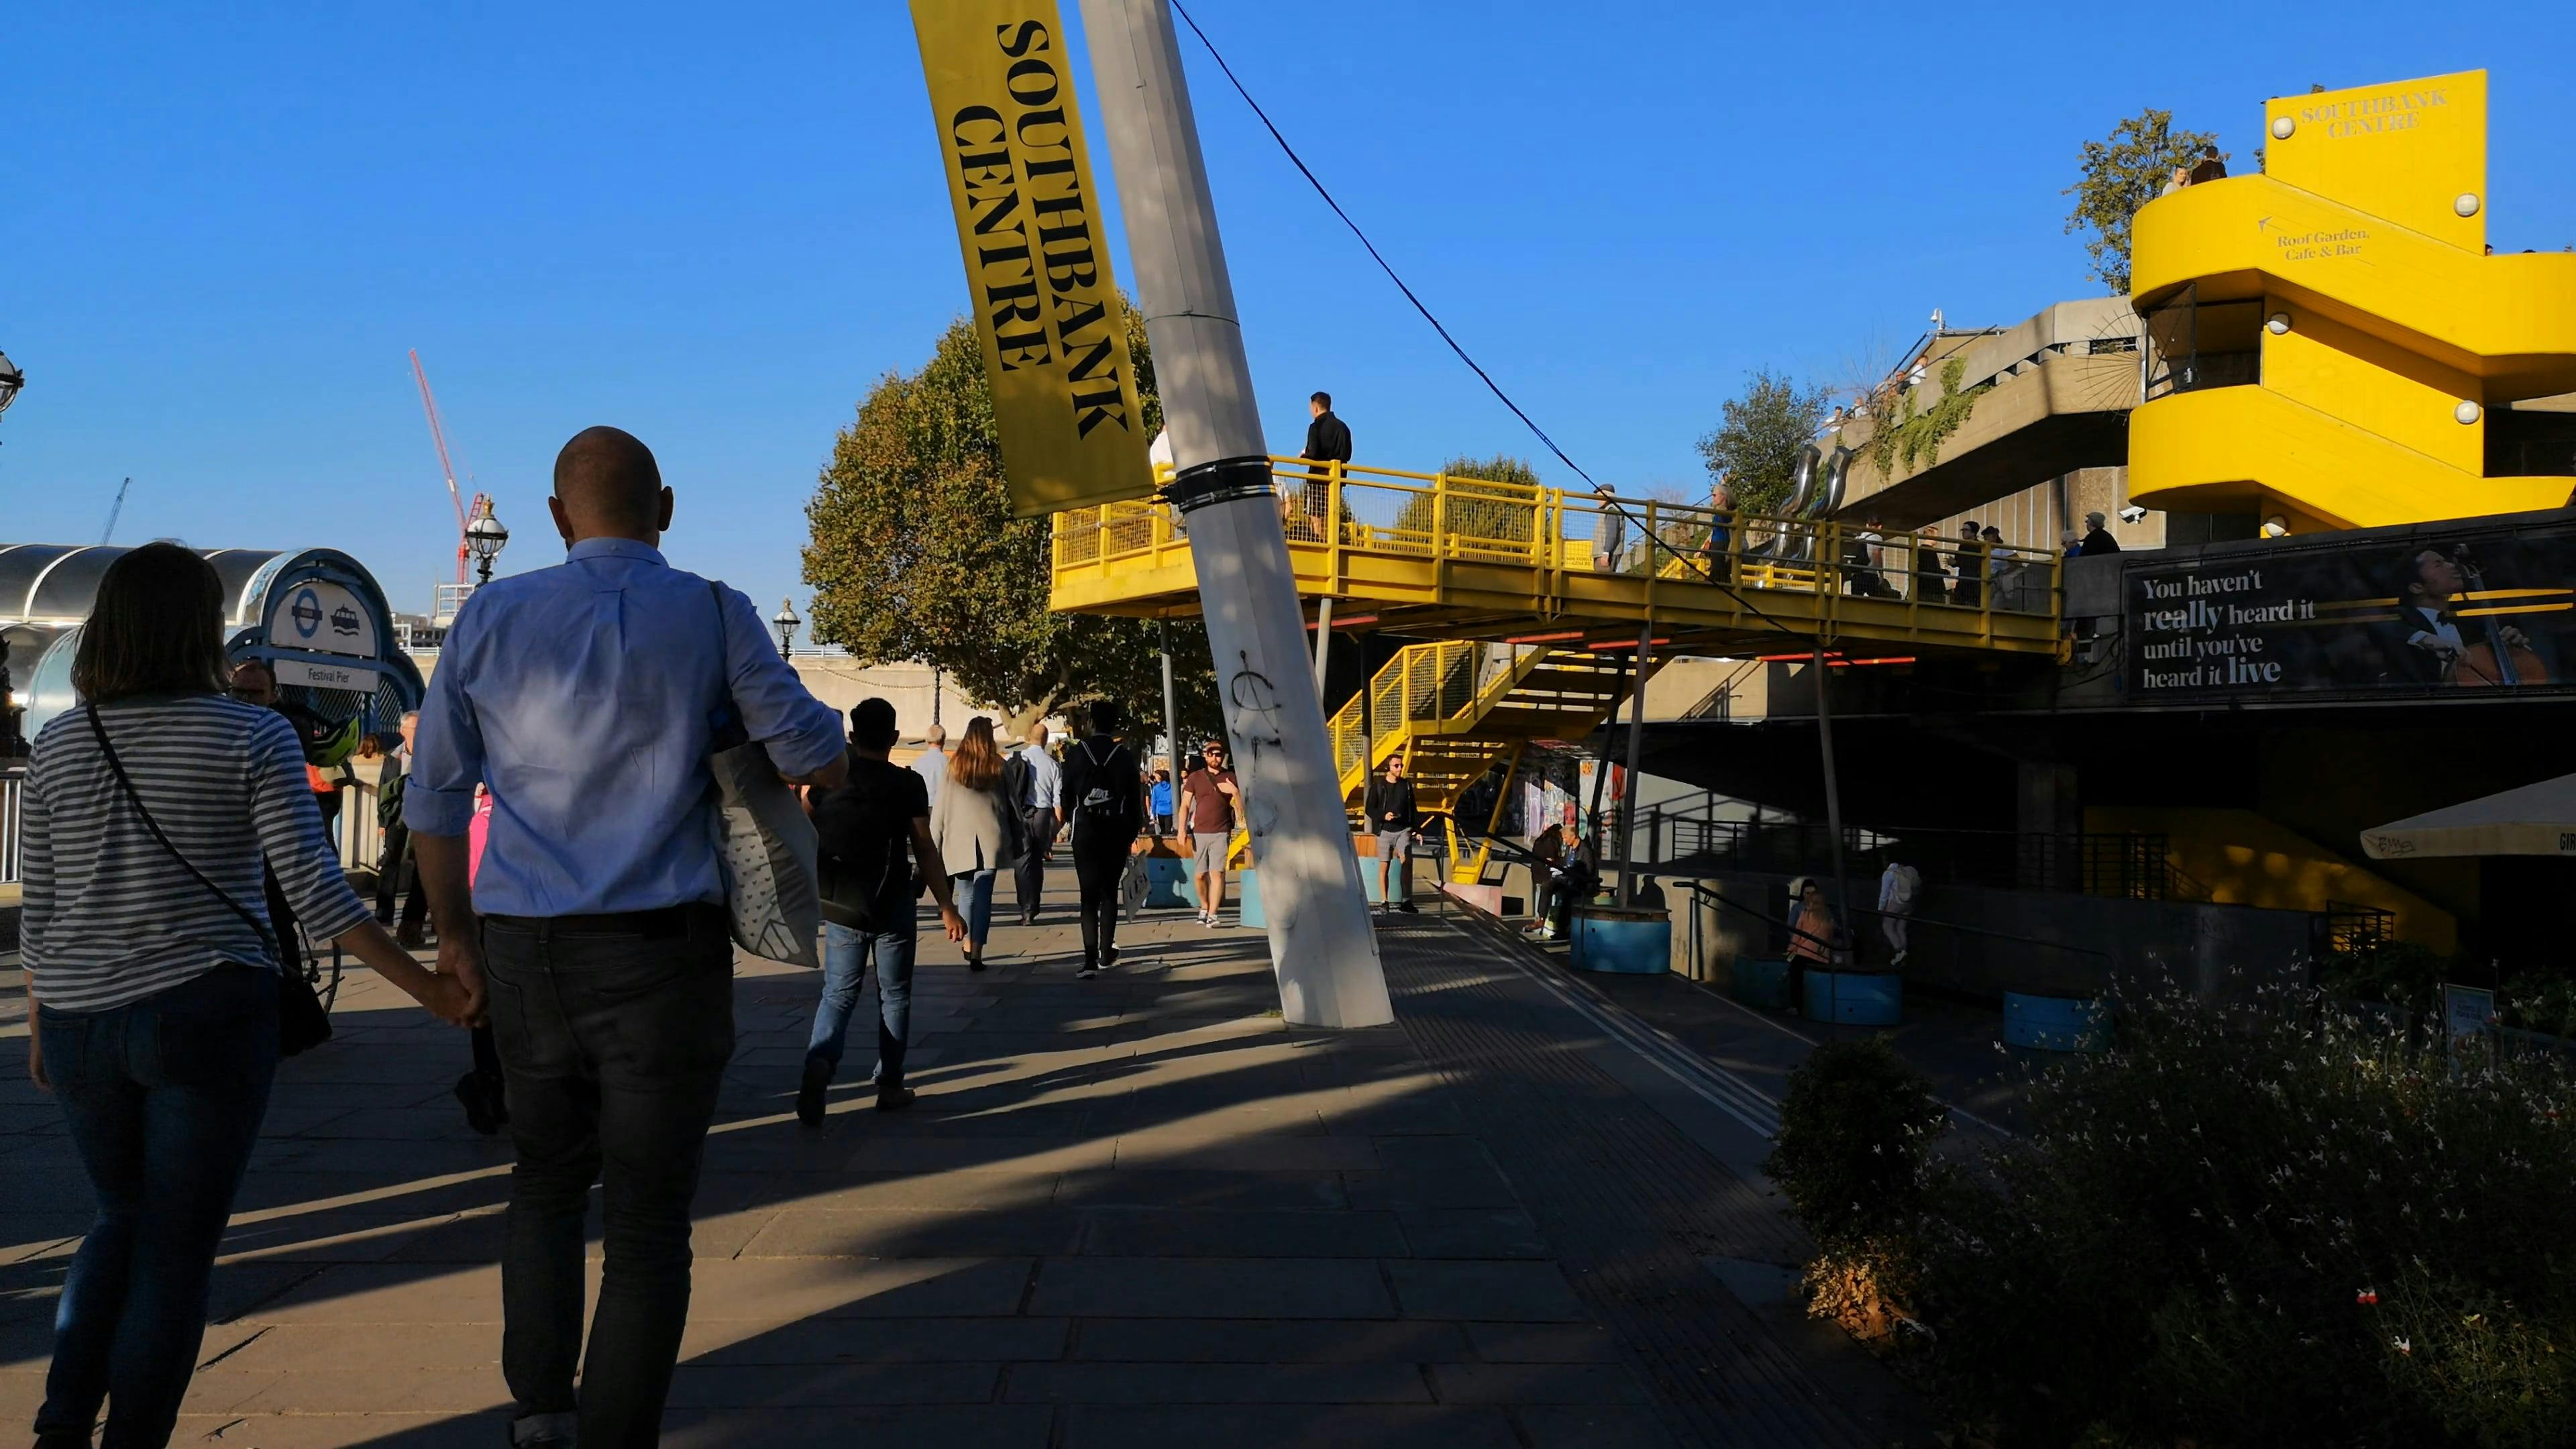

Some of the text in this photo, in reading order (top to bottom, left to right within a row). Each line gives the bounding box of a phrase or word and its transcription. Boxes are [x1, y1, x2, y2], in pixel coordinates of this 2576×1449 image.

[2302, 88, 2448, 124] SOUTHBANK
[2328, 111, 2420, 139] CENTRE
[953, 105, 1052, 371] CENTRE
[997, 19, 1128, 441] SOUTHBANK
[2277, 233, 2312, 247] Roof
[2320, 246, 2332, 257] &
[2336, 244, 2361, 256] Bar
[2143, 570, 2263, 599] You haven't
[2144, 599, 2316, 635] really heard it
[2144, 633, 2263, 662] until you've
[309, 668, 350, 683] Festival Pier
[2143, 657, 2281, 688] heard it live
[1089, 788, 1109, 798] NIKE
